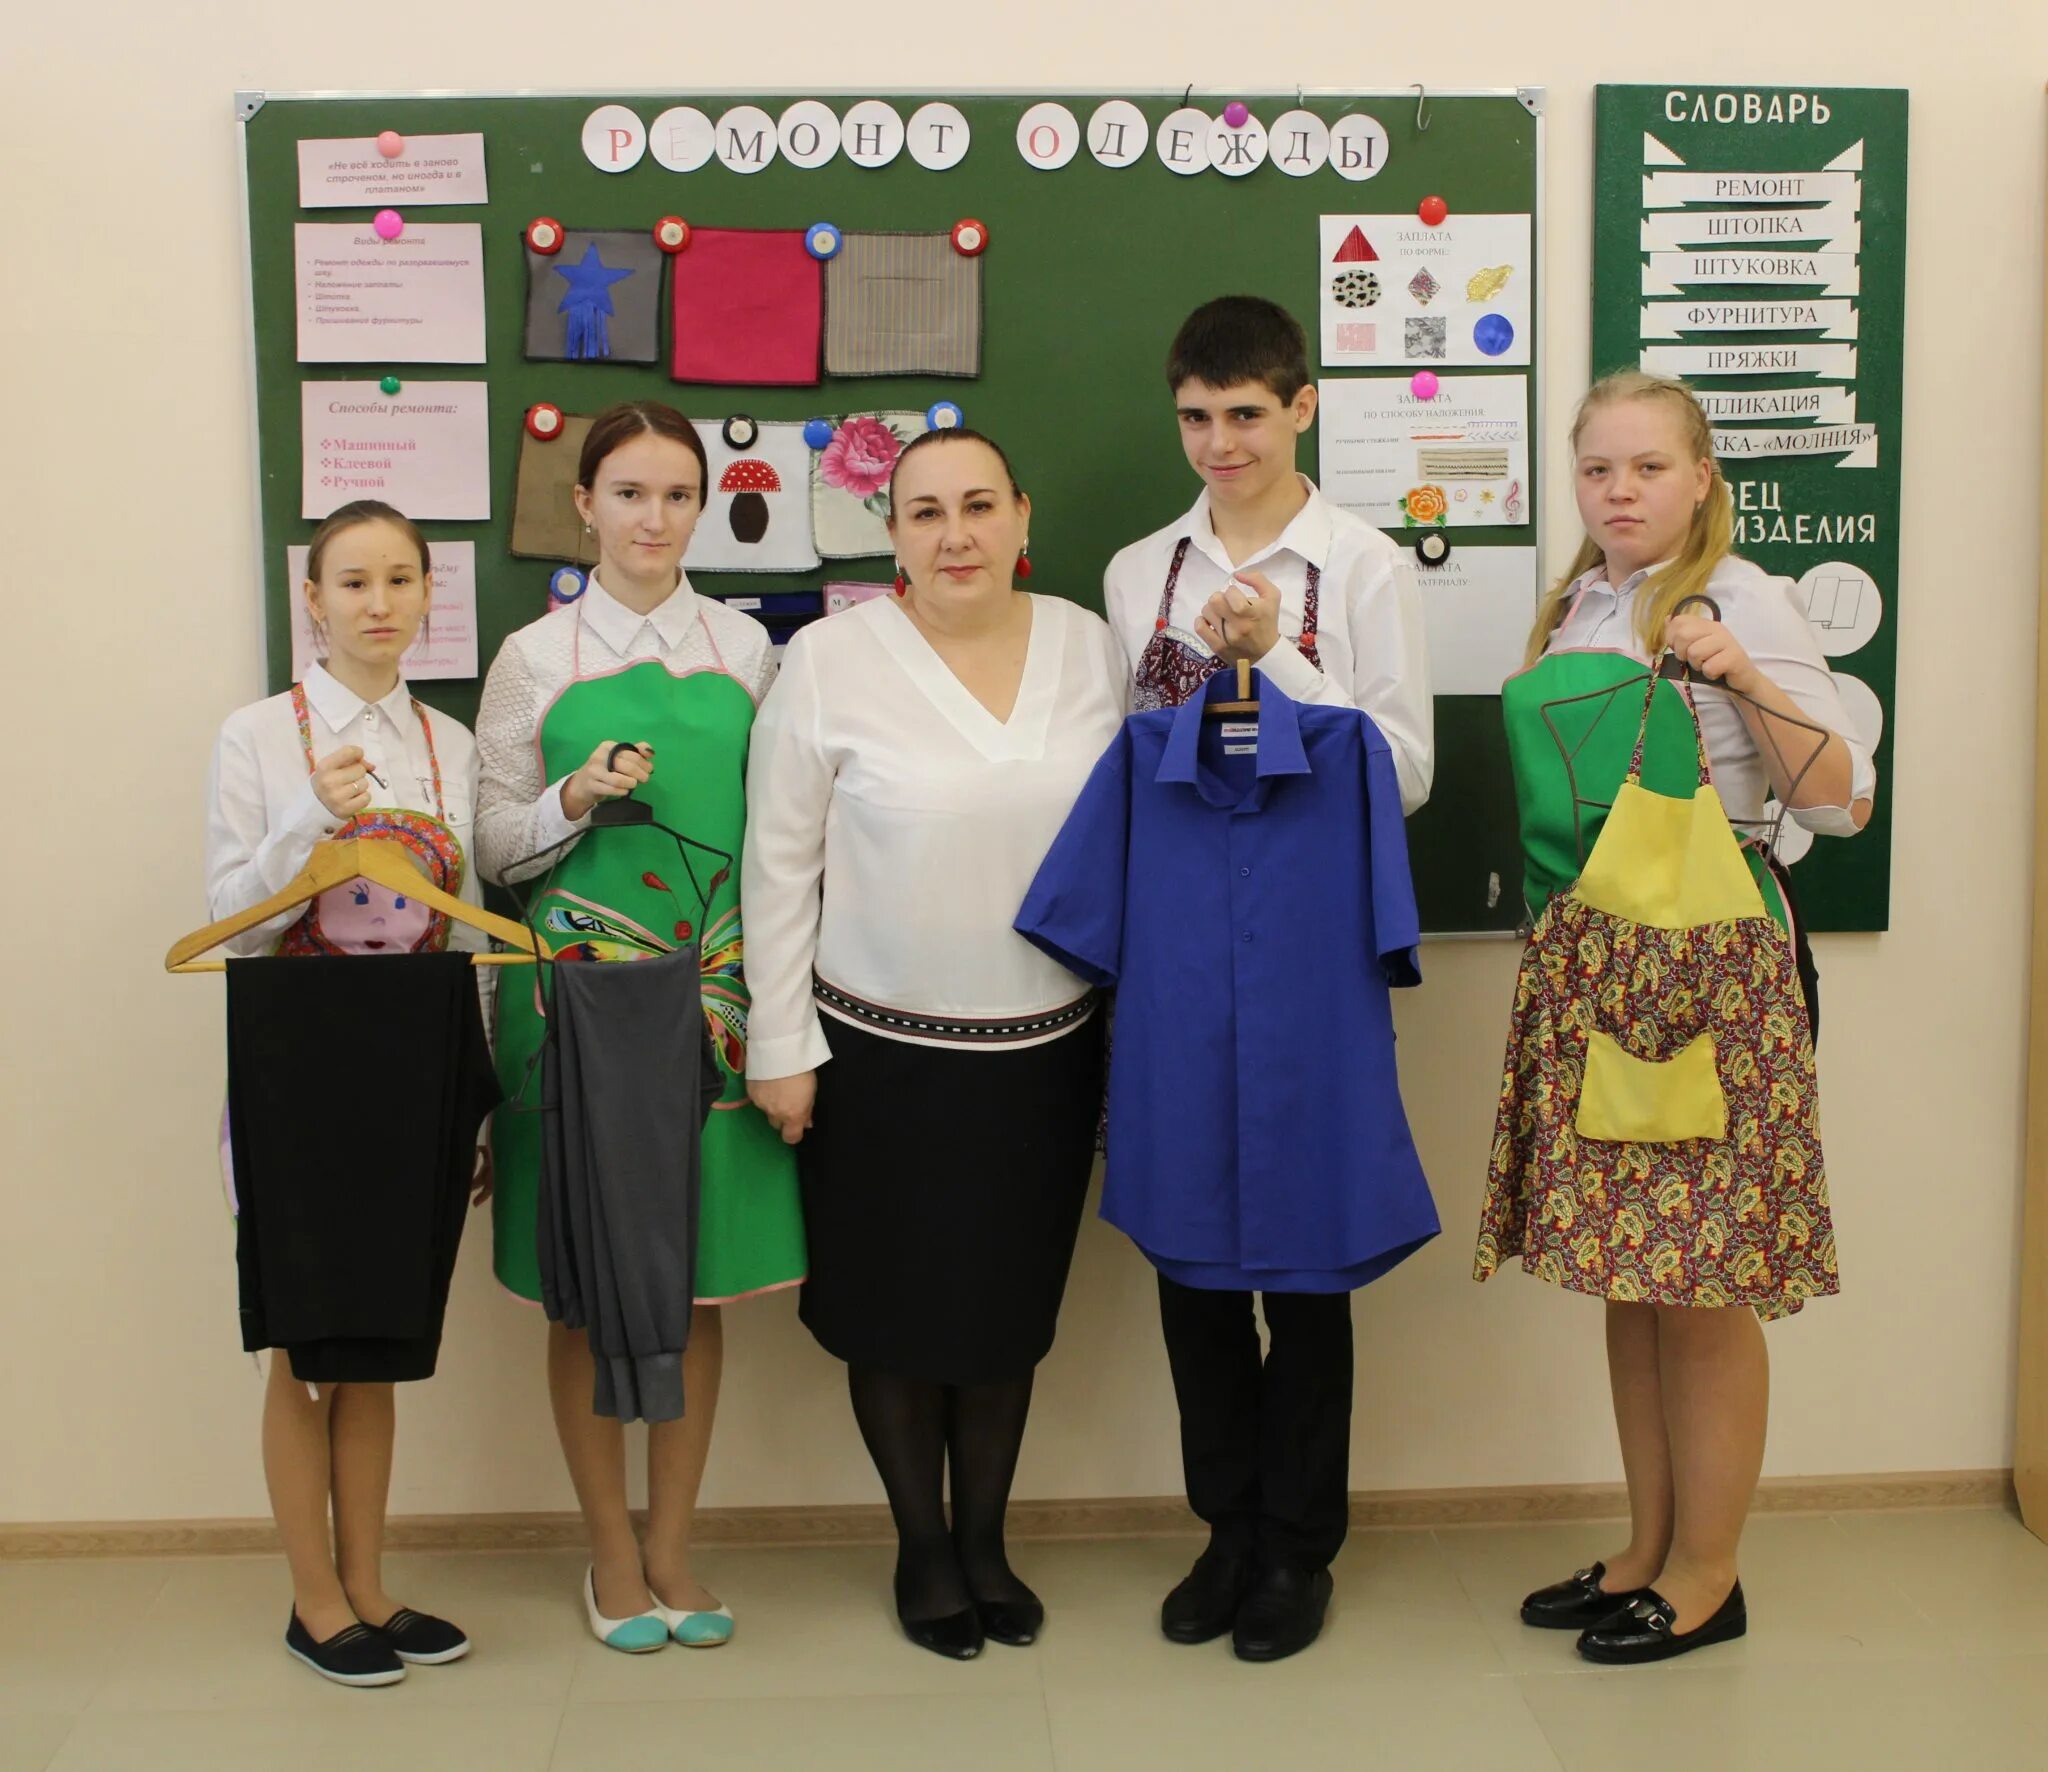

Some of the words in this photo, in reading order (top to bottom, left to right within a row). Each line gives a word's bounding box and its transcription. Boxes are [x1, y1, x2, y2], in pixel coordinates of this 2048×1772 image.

[1665, 91, 1831, 125] СЛОВАРЬ
[605, 122, 953, 164] РЕМОНТ
[1029, 122, 1378, 170] ОДЕЖДЫ
[423, 159, 459, 168] заново
[407, 171, 444, 181] иногда
[1715, 179, 1805, 197] РЕМОНТ
[1708, 216, 1804, 236] ШТОПКА
[1396, 231, 1452, 241] ЗАПЛАТА
[1400, 248, 1413, 256] ПО
[1694, 258, 1818, 276] ШТУКОВКА
[1687, 305, 1818, 325] ФУРНИТУРА
[1707, 350, 1798, 369] ПРЯЖКИ
[328, 401, 388, 414] Способы
[390, 402, 458, 416] ремонта:
[1699, 394, 1820, 414] ПЛИКАЦИЯ
[1381, 409, 1423, 419] СПОСОБУ
[334, 438, 417, 451] Машинный
[333, 458, 392, 469] Клеевой
[333, 476, 385, 490] Ручной
[1731, 514, 1876, 545] ИЗДЕЛИЯ
[1415, 562, 1462, 572] АПЛАТА
